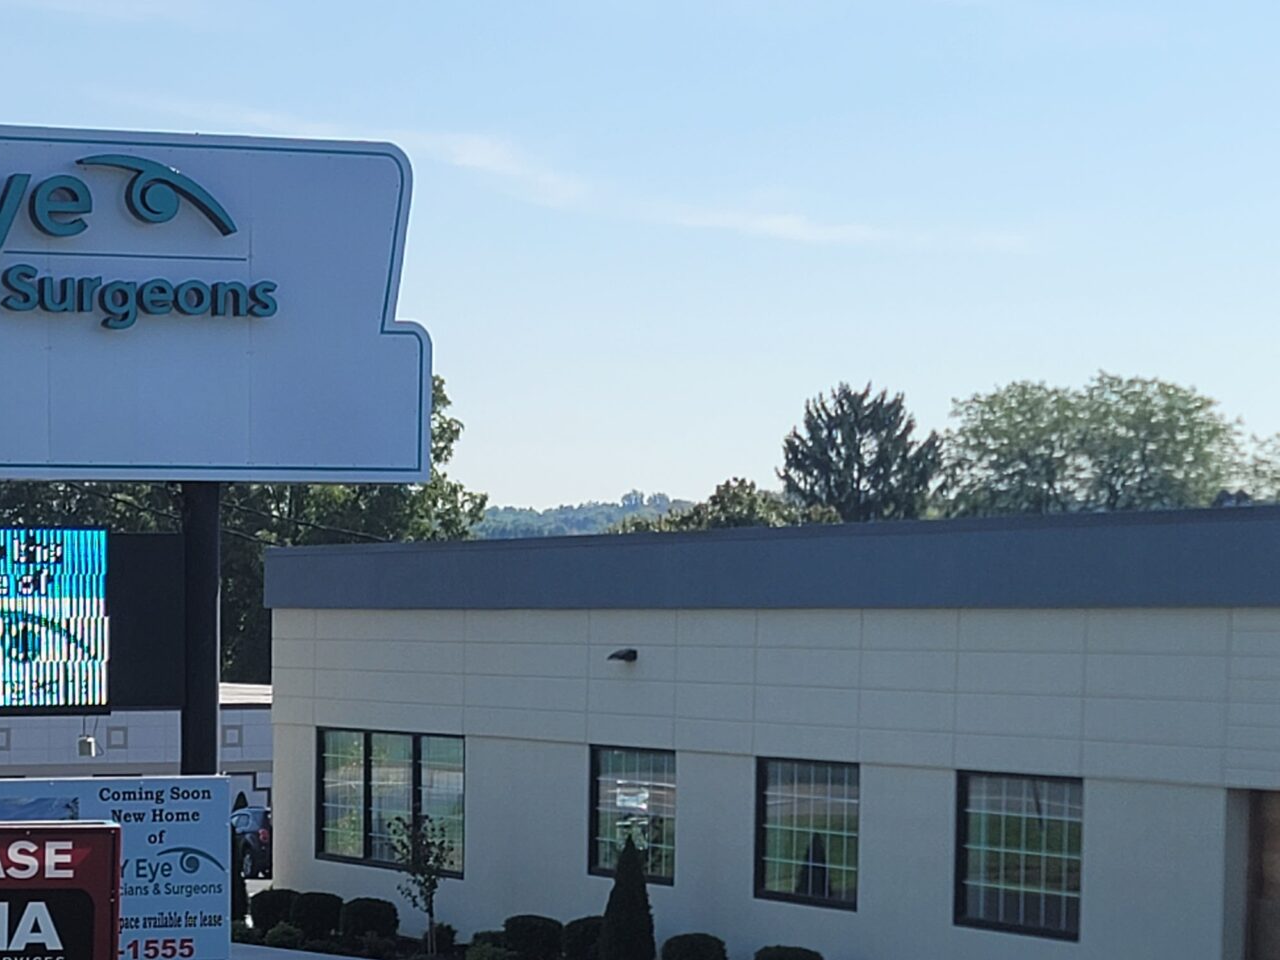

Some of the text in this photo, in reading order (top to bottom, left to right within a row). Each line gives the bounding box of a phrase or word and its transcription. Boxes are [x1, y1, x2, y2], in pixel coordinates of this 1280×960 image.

[1, 263, 279, 330] Surgeons
[98, 787, 212, 804] Coming Soon
[111, 809, 201, 824] New Home
[147, 831, 166, 844] of
[135, 859, 173, 883] Eye
[152, 883, 161, 895] &
[164, 883, 223, 898] Surgeons
[119, 911, 223, 935] pace available for lease
